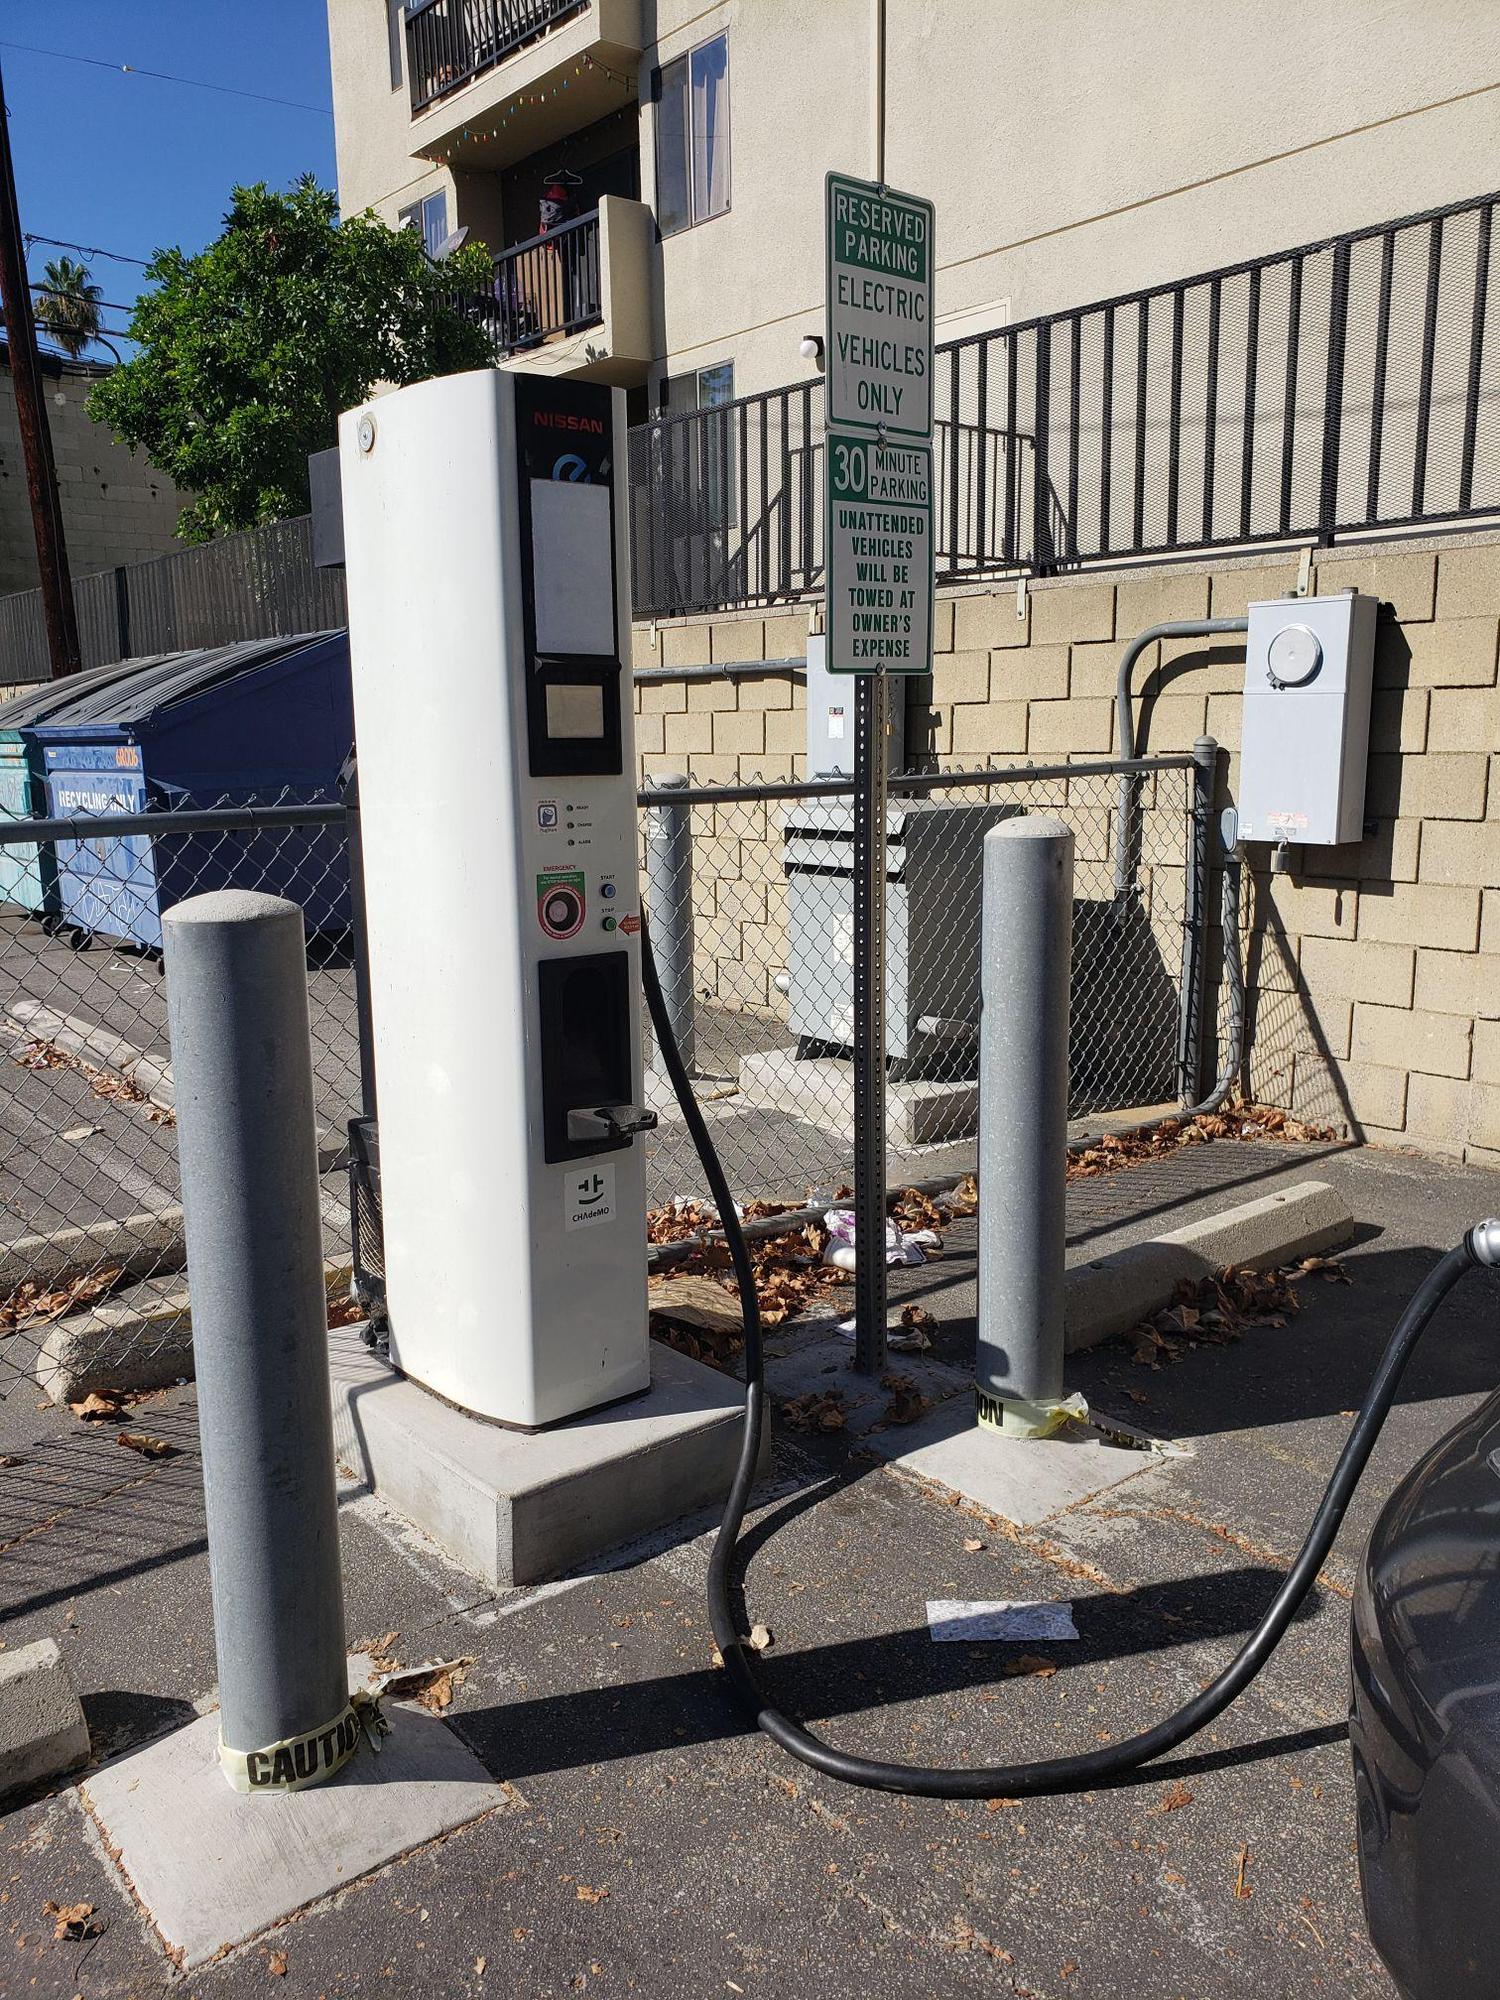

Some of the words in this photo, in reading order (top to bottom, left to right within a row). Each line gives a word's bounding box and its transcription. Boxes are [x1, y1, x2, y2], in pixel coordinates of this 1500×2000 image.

[836, 194, 925, 243] RESERVED
[845, 231, 919, 274] PARKING
[838, 275, 925, 323] ELECTRIC
[837, 332, 925, 377] VEHICLES
[857, 380, 903, 416] ONLY
[534, 411, 603, 433] NISSAN
[834, 445, 866, 493] 30
[875, 450, 922, 476] MINUTE
[871, 476, 927, 501] PARKING
[839, 510, 924, 535] UNATTENDED
[852, 536, 913, 559] VEHICLES
[857, 563, 887, 583] WILL
[893, 565, 909, 584] BE
[848, 588, 893, 608] TOWED
[900, 590, 915, 609] AT
[852, 614, 911, 633] OWNER'S
[852, 639, 910, 657] EXPENSE
[59, 791, 107, 809] RECYCLING
[572, 1207, 609, 1222] CHAdeMO
[247, 1712, 361, 1786] CAUTIO
